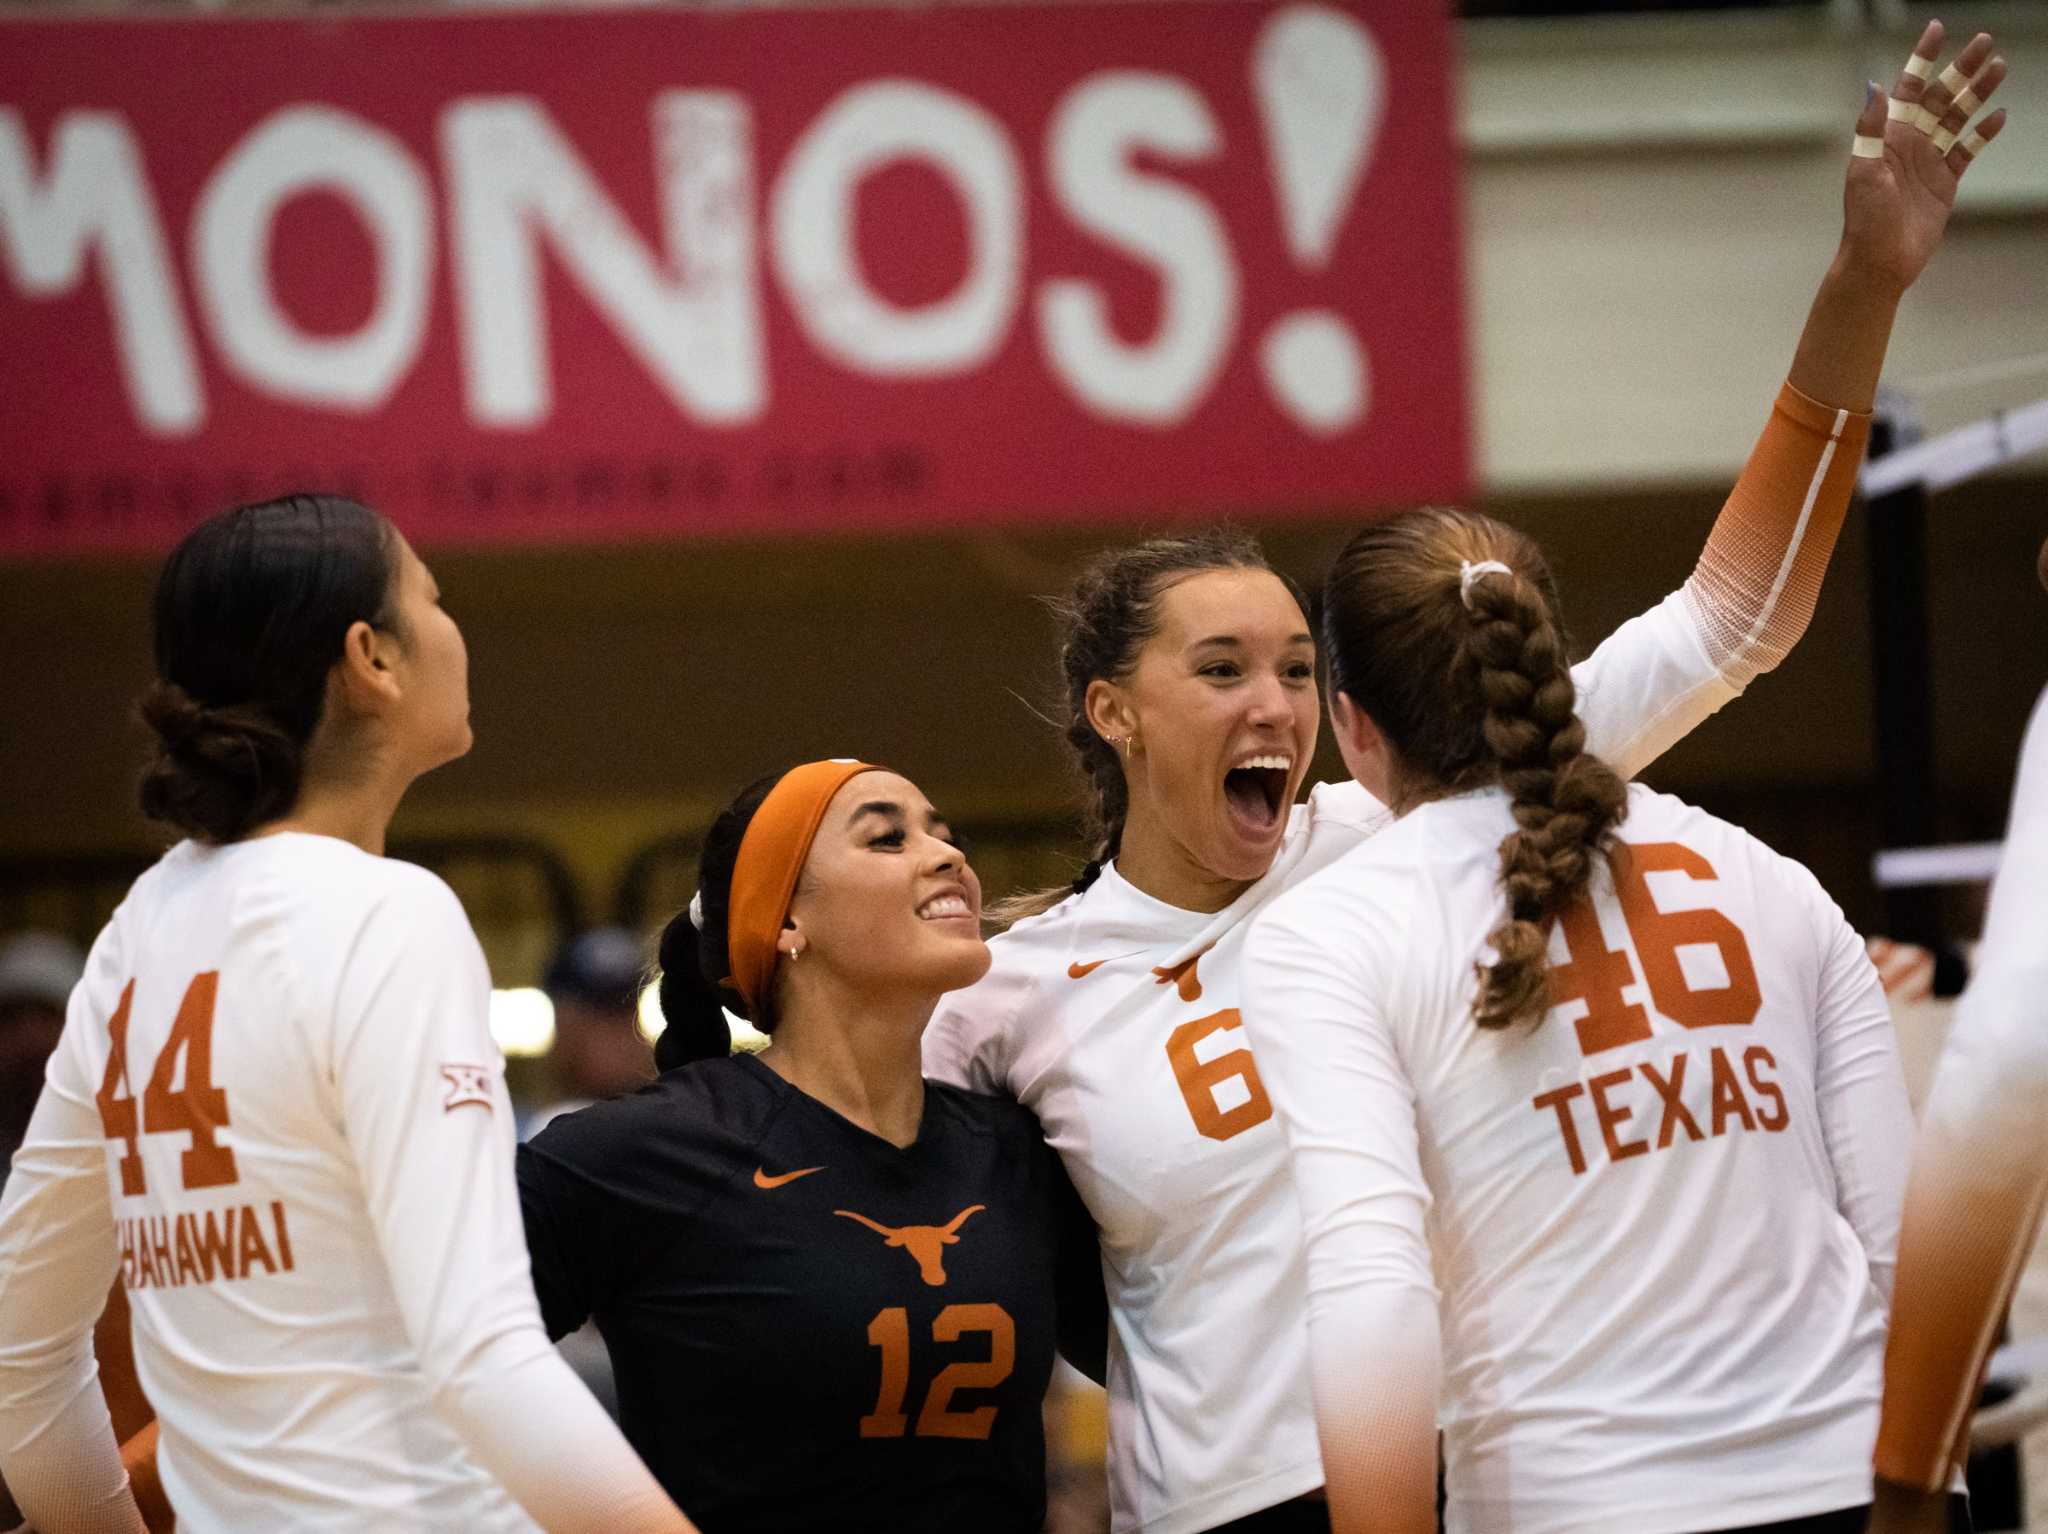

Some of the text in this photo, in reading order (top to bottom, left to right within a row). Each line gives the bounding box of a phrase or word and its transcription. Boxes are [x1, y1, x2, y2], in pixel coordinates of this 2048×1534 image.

[0, 4, 1389, 438] MONOS!
[1542, 841, 1763, 1057] 46
[96, 970, 240, 1197] 44
[1165, 1008, 1273, 1142] 6
[1532, 1045, 1790, 1176] TEXAS
[115, 1200, 295, 1290] HAHAWAI
[859, 1302, 1016, 1440] 12
